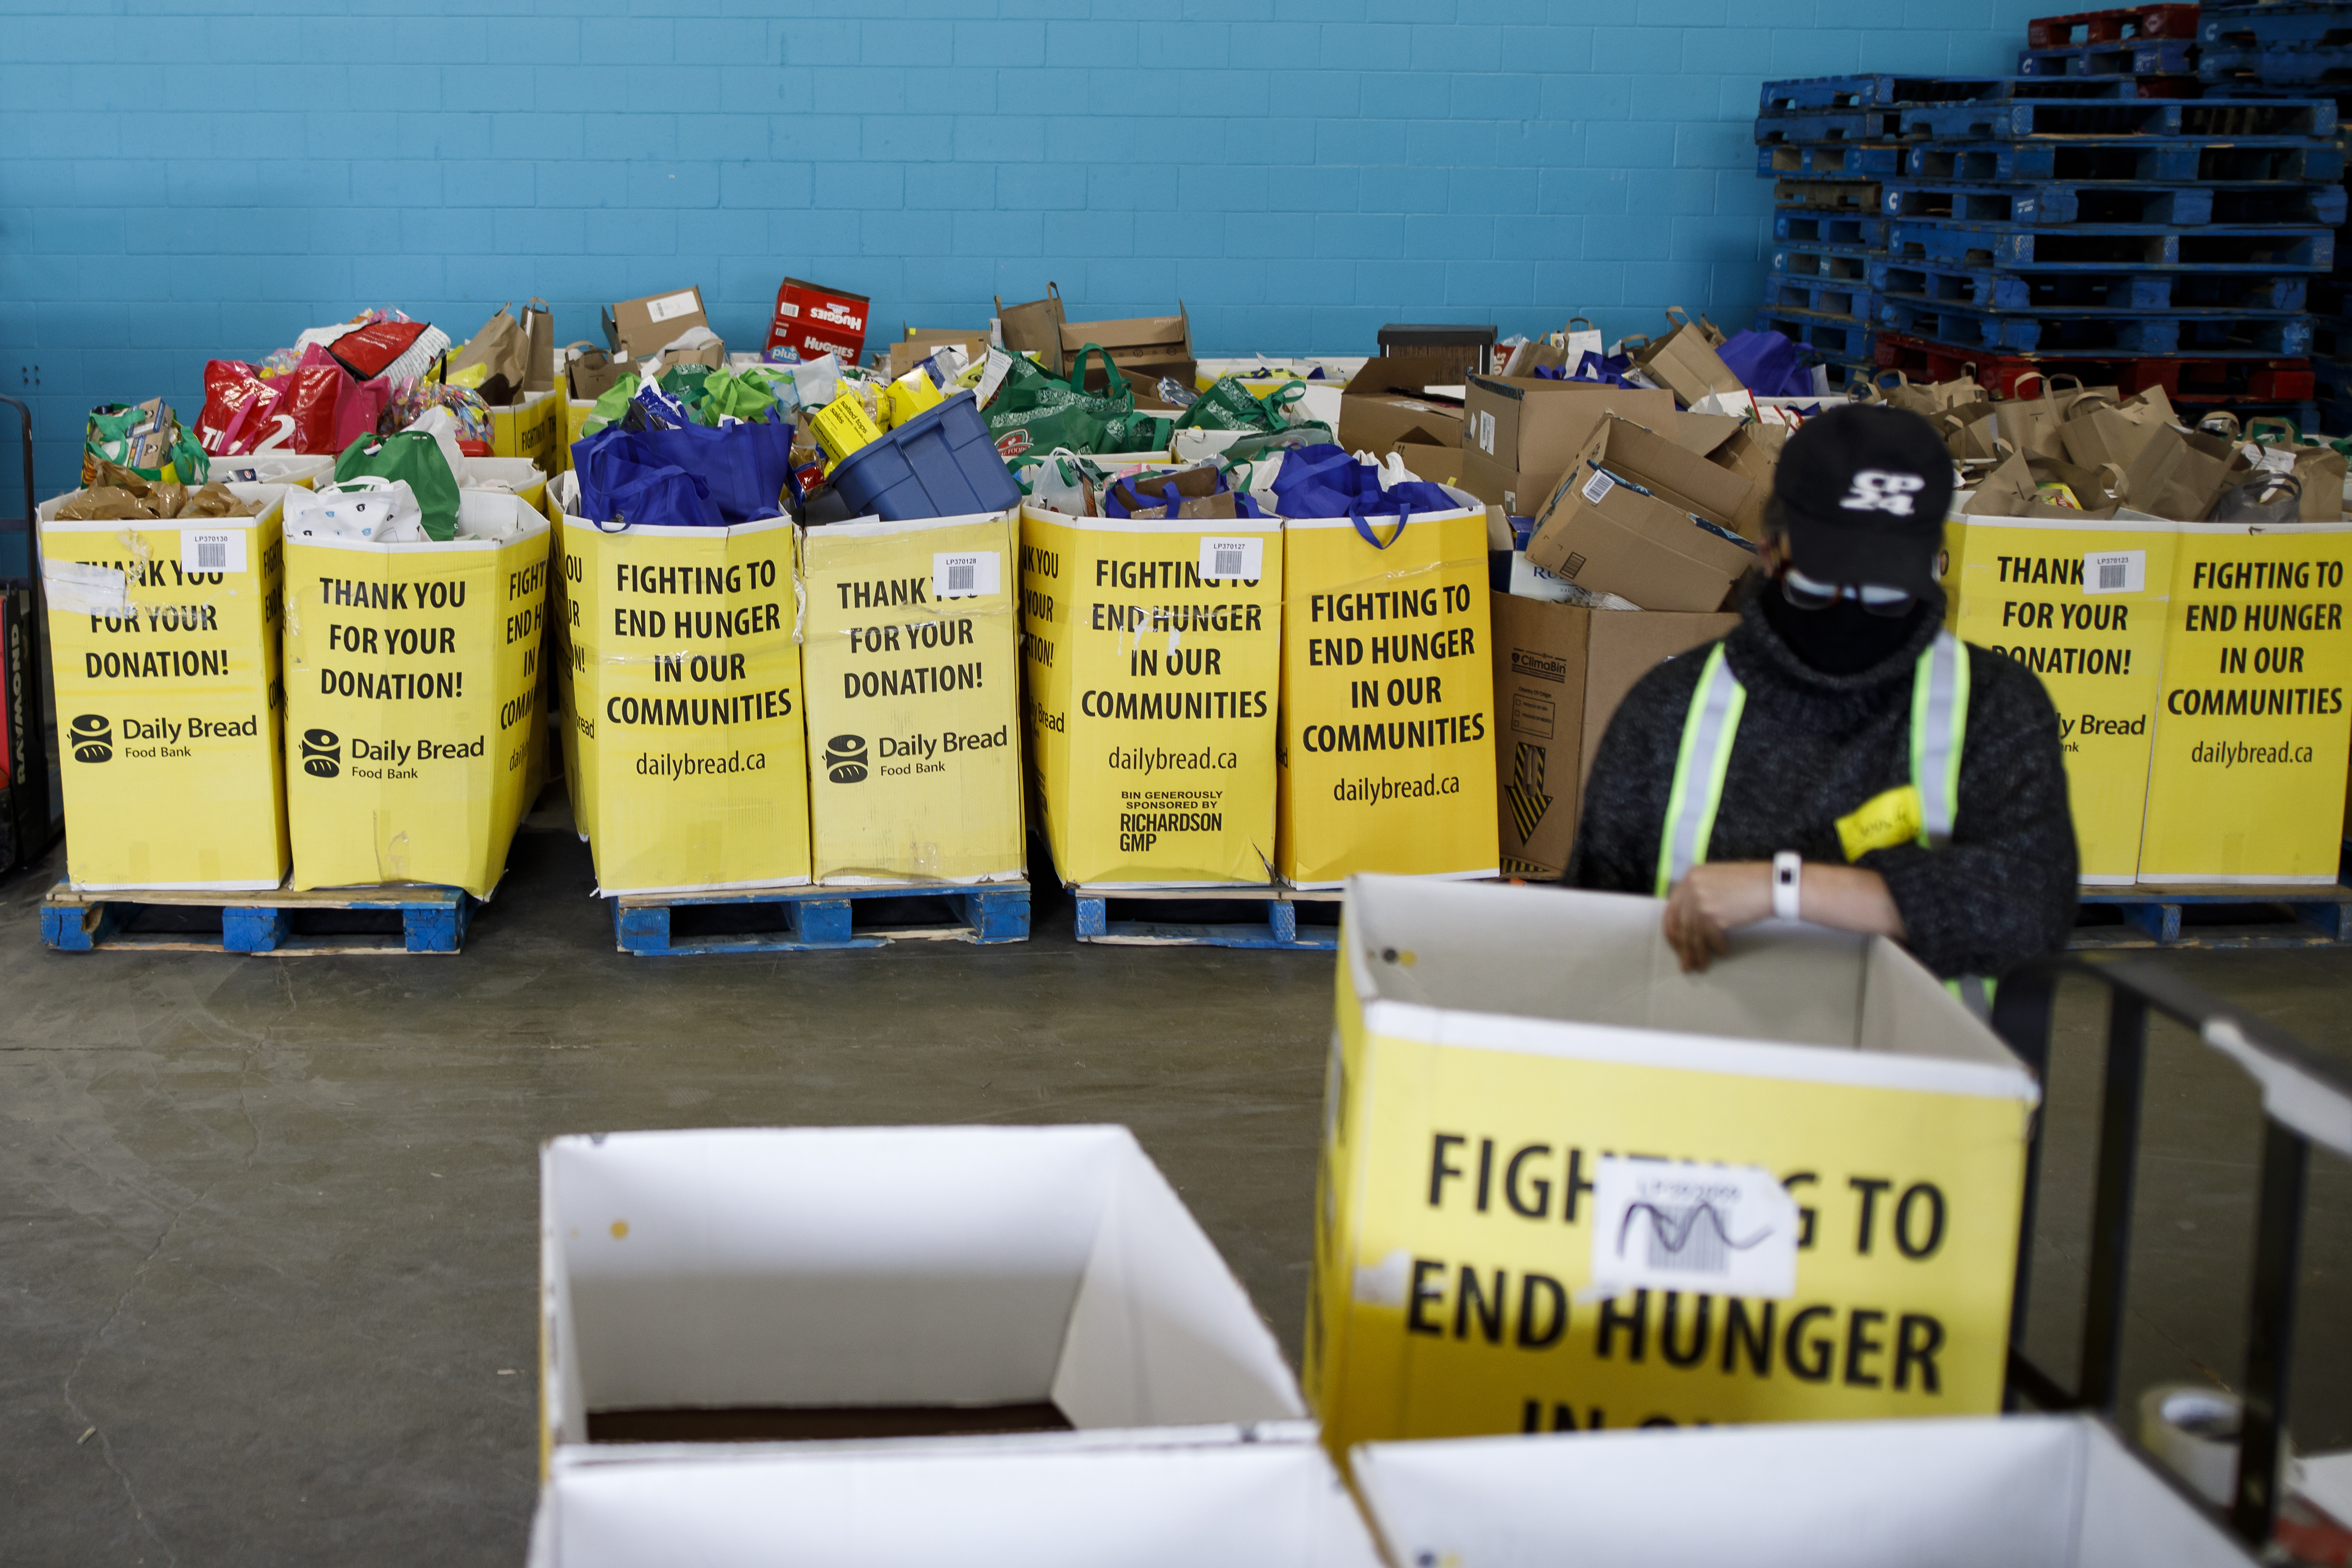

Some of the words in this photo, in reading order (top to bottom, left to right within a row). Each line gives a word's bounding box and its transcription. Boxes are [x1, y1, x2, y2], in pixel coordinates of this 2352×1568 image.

[772, 348, 797, 361] plus
[804, 336, 854, 358] HUGGIES
[840, 401, 857, 420] salted
[855, 419, 867, 434] tops
[252, 414, 296, 455] 2
[1852, 468, 1926, 493] CP
[1838, 486, 1915, 517] 24
[566, 555, 582, 583] OU
[617, 563, 741, 594] FIGHTING
[747, 559, 776, 589] TO
[1036, 547, 1059, 579] YOU
[1998, 556, 2084, 585] THANK
[2193, 562, 2311, 589] FIGHTING
[2317, 561, 2343, 588] TO
[320, 577, 408, 610] THANK
[413, 581, 466, 609] YOU
[510, 559, 546, 601] FIGHT
[837, 577, 927, 609] THANK
[1026, 588, 1054, 623] YOUR
[1093, 603, 1144, 633] END
[1153, 604, 1261, 632] HUNGER
[1311, 588, 1437, 622] FIGHTING
[1443, 584, 1470, 615] TO
[2002, 601, 2053, 629] FOR
[2061, 603, 2128, 631] YOUR
[2185, 604, 2238, 632] END
[2244, 603, 2343, 632] HUNGER
[90, 606, 140, 633] FOR
[144, 605, 218, 632] YOUR
[507, 609, 532, 645] END
[615, 608, 666, 638] END
[675, 603, 780, 639] HUNGER
[330, 624, 378, 654] FOR
[384, 627, 456, 655] YOUR
[851, 625, 900, 653] FOR
[905, 619, 974, 649] YOUR
[1026, 631, 1054, 668] ATION!
[1309, 638, 1364, 666] END
[1372, 627, 1475, 664] HUNGER
[85, 650, 229, 678] DONATION!
[524, 647, 535, 678] IN
[654, 655, 681, 682] IN
[690, 653, 746, 682] OUR
[1131, 649, 1157, 676] IN
[1166, 649, 1221, 676] OUR
[1521, 655, 1566, 674] ClimaBin
[2220, 648, 2248, 674] IN
[2254, 647, 2304, 674] OUR
[321, 668, 463, 699] DONATION!
[844, 662, 983, 698] DONATION!
[1351, 680, 1379, 708] IN
[1387, 676, 1442, 706] OUR
[12, 624, 25, 785] RAYMOND
[607, 688, 792, 726] COMMUNITIES
[1081, 690, 1267, 720] COMMUNITIES
[2167, 688, 2343, 715] COMMUNITIES
[123, 718, 182, 744] Daily
[188, 715, 257, 737] Bread
[1038, 702, 1064, 734] Bread
[1303, 712, 1485, 752] COMMUNITIES
[2080, 714, 2146, 736] Bread
[125, 747, 156, 758] Food
[160, 746, 191, 757] Bank
[352, 738, 411, 765] Daily
[418, 736, 485, 760] Bread
[879, 734, 937, 760] Daily
[943, 725, 1008, 752] Bread
[2192, 741, 2313, 769] dailybread.ca
[352, 767, 382, 779] Food
[387, 768, 418, 780] Bank
[636, 750, 766, 781] dailybread.ca
[881, 765, 911, 776] Food
[915, 761, 946, 774] Bank
[1108, 746, 1237, 775] dailybread.ca
[1126, 801, 1199, 809] SPONSORED
[1334, 773, 1460, 806] dailybread.ca
[1120, 813, 1222, 832] RICHARDSON
[1119, 833, 1157, 852] GMP
[1848, 1175, 1947, 1261] TO
[1407, 1258, 1570, 1352] END
[1595, 1288, 1946, 1397] HUNGER
